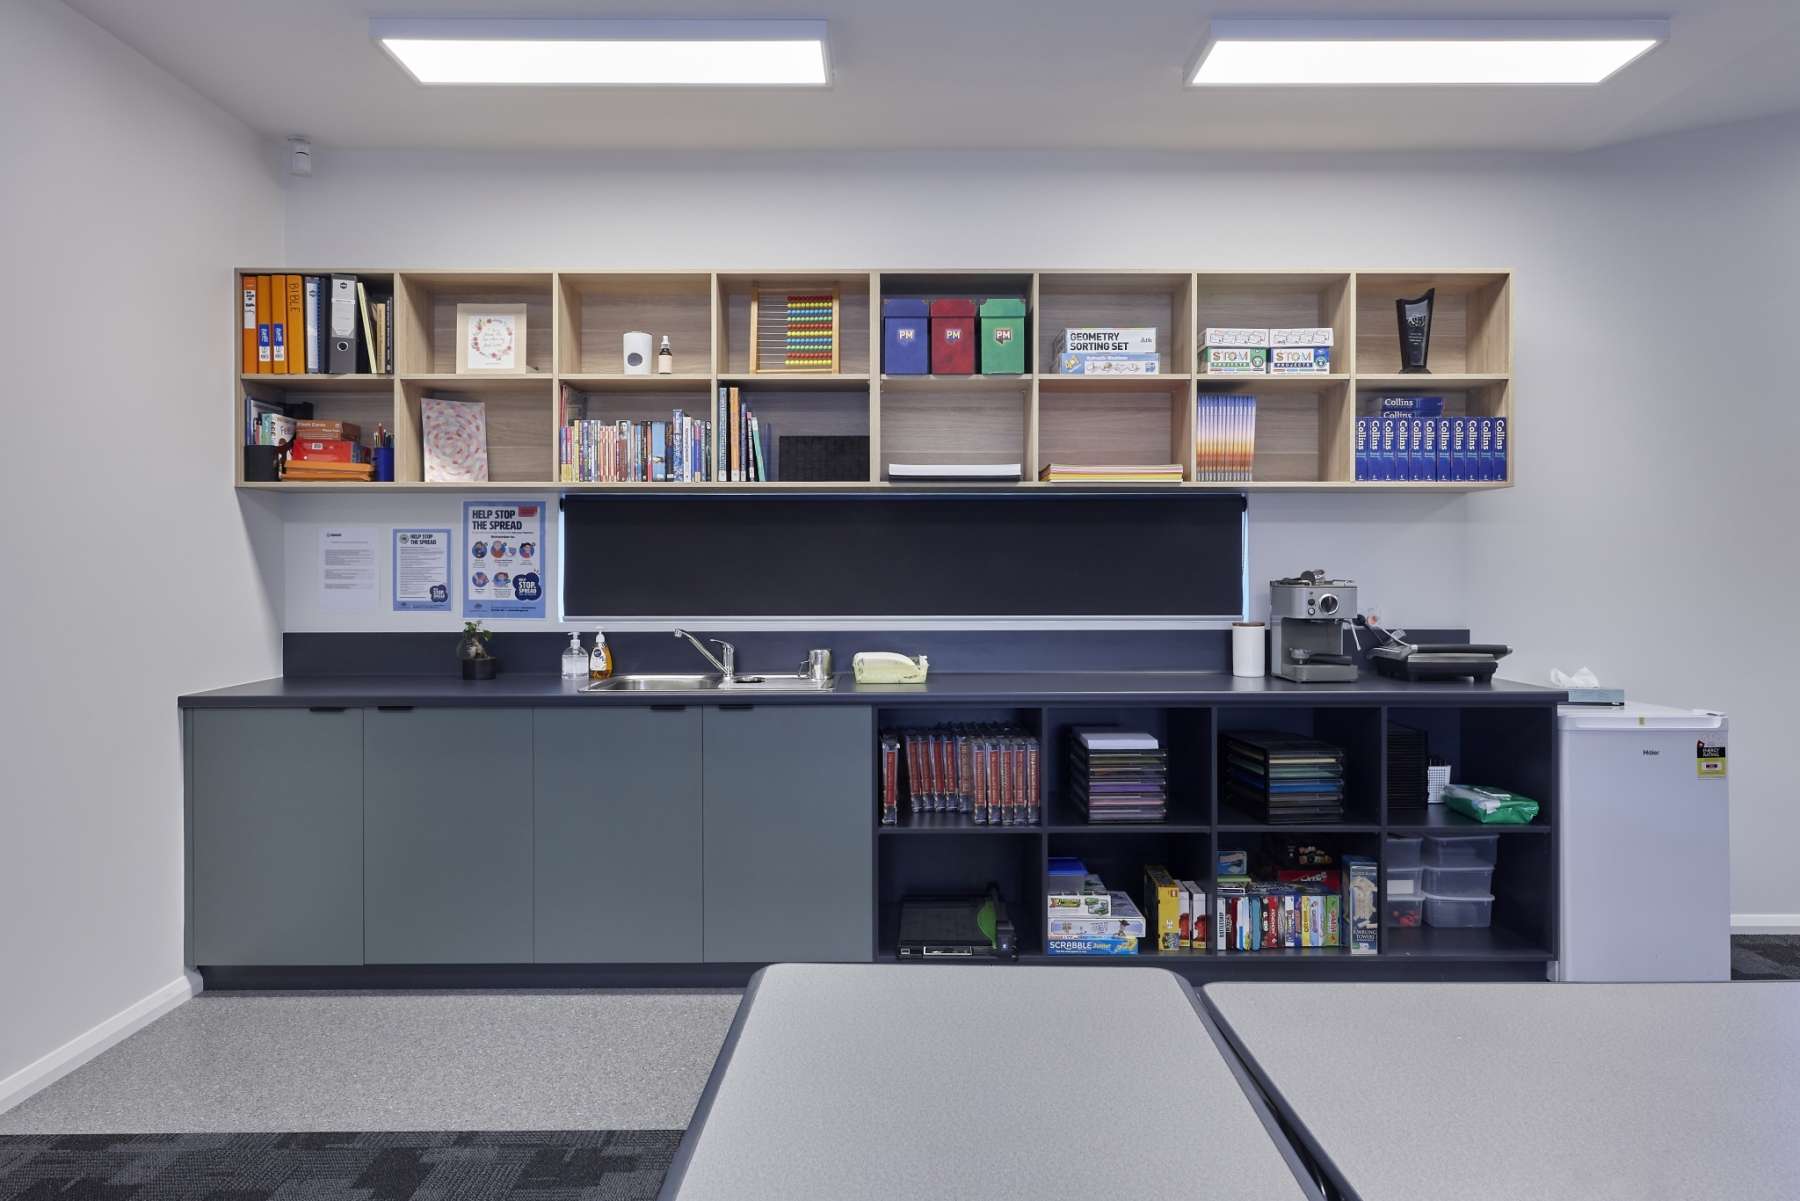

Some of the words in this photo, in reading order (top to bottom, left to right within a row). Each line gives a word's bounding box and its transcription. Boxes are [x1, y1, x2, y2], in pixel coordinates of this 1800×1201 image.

[899, 329, 914, 340] PM
[946, 329, 961, 340] PM
[996, 330, 1011, 340] PM
[1070, 332, 1120, 341] GEOMETRY
[1070, 342, 1110, 351] SORTING
[1111, 342, 1129, 351] SET
[1384, 397, 1414, 406] Collins
[1358, 420, 1366, 450] Collins
[1372, 420, 1380, 450] Collins
[1385, 420, 1393, 450] Collins
[1400, 420, 1408, 450] Collins
[1413, 420, 1421, 450] Collins
[1426, 420, 1434, 450] Collins
[1441, 420, 1449, 450] Collins
[1455, 420, 1463, 450] Collins
[1469, 420, 1477, 450] Collins
[1483, 420, 1491, 450] Collins
[1496, 420, 1505, 450] Collins
[472, 510, 493, 519] HELP
[494, 510, 516, 519] STOP
[472, 521, 488, 530] THE
[489, 521, 523, 530] SPREAD
[1049, 941, 1092, 950] SCRABBLE
